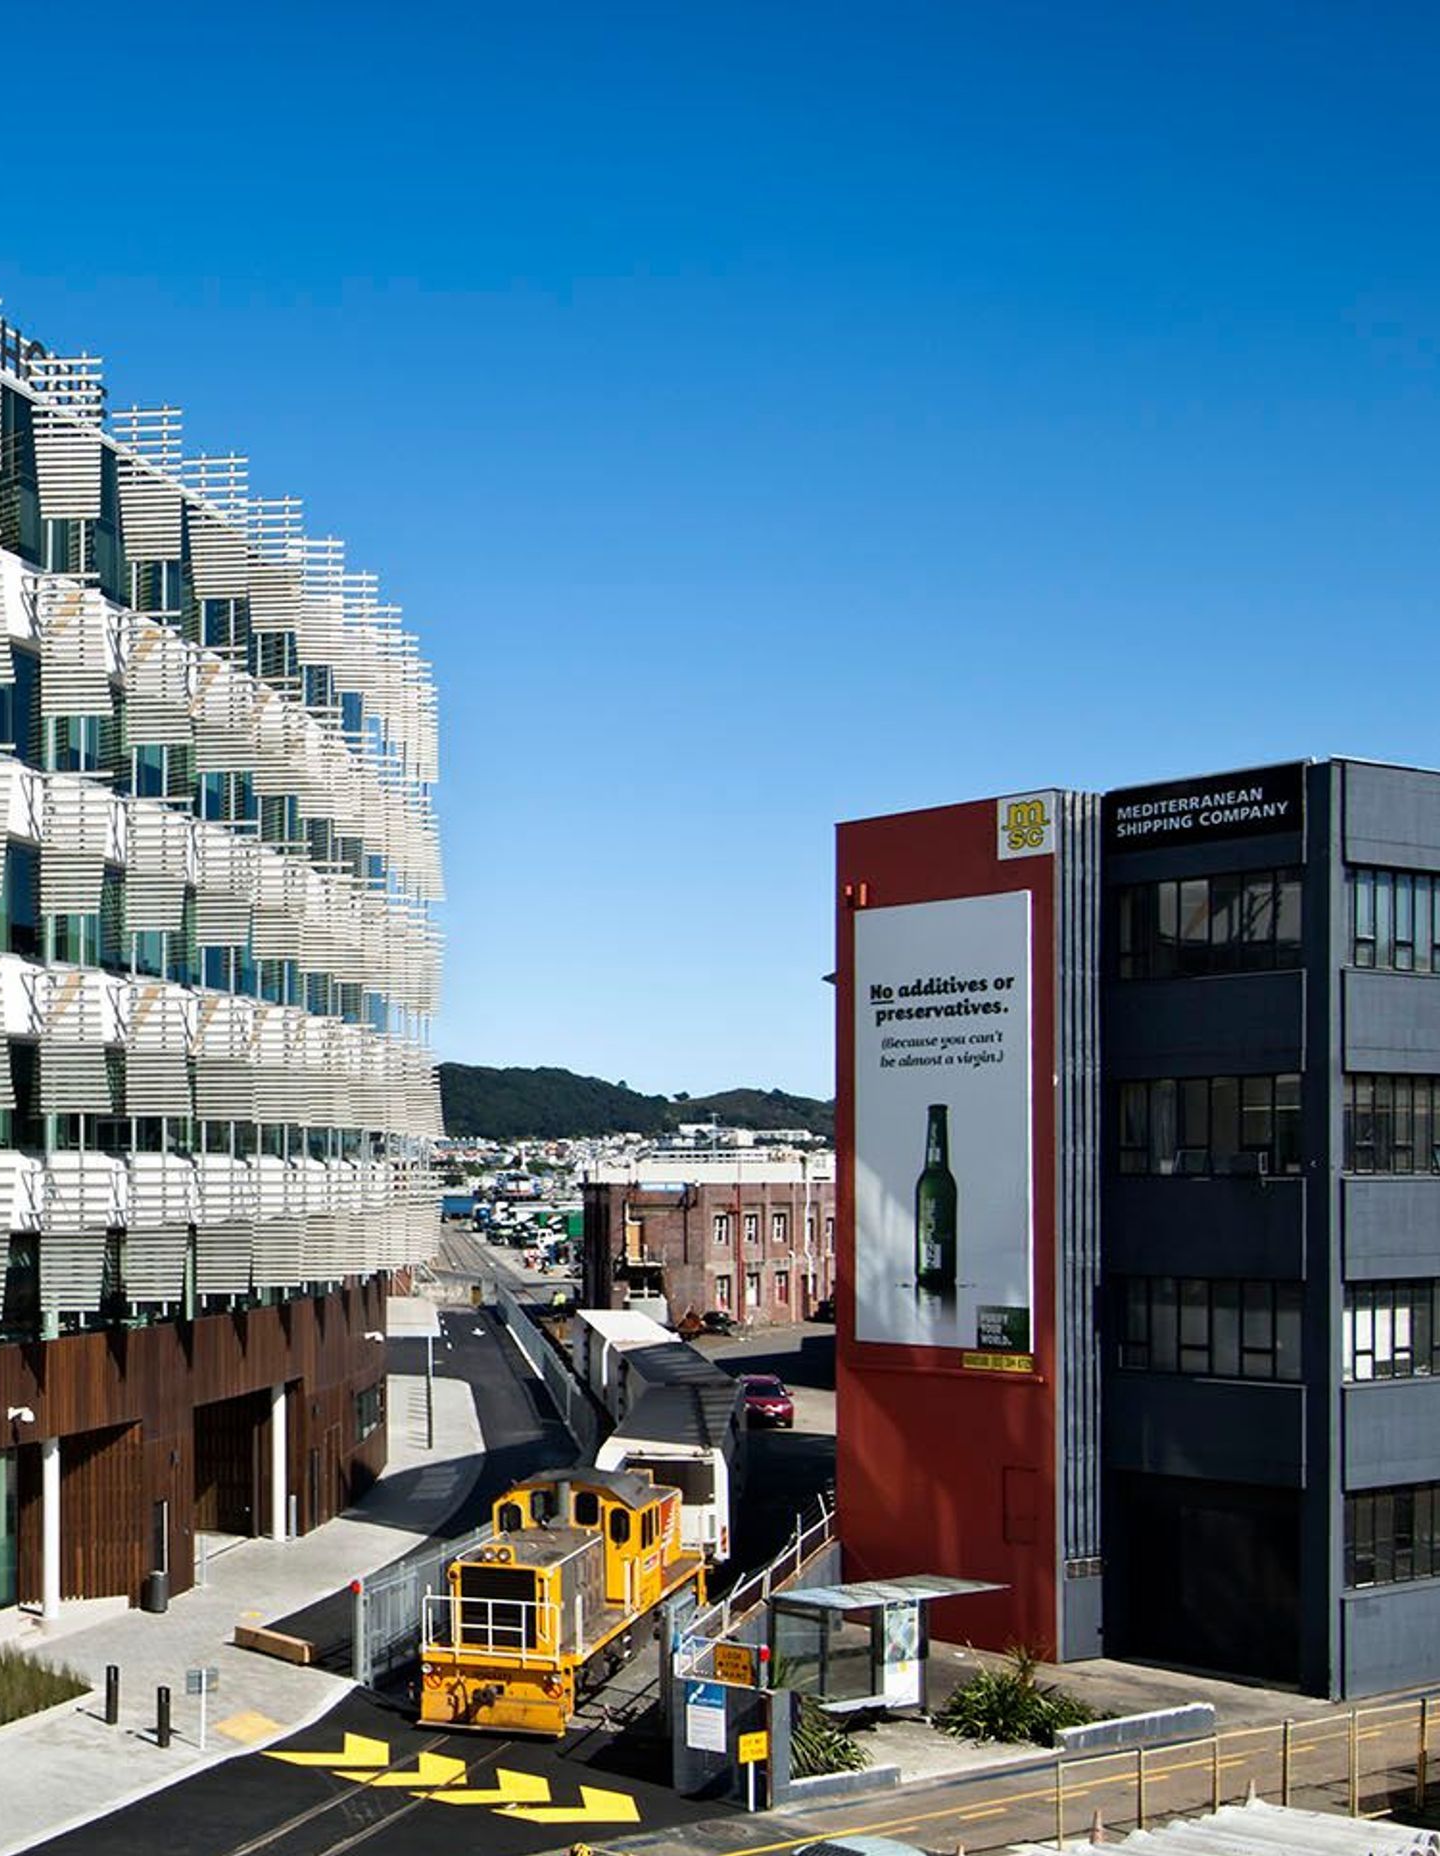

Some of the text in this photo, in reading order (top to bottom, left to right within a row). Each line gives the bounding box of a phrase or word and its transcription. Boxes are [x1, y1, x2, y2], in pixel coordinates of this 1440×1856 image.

[1117, 787, 1263, 821] MEDITERRANEAN
[1117, 801, 1290, 838] SHIPPING COMPANY
[870, 976, 1015, 1004] No additives or
[876, 999, 1009, 1027] preservatives.
[881, 1030, 1003, 1050] (Because you can't
[880, 1054, 895, 1068] be
[898, 1054, 942, 1067] almost
[945, 1056, 954, 1065] a
